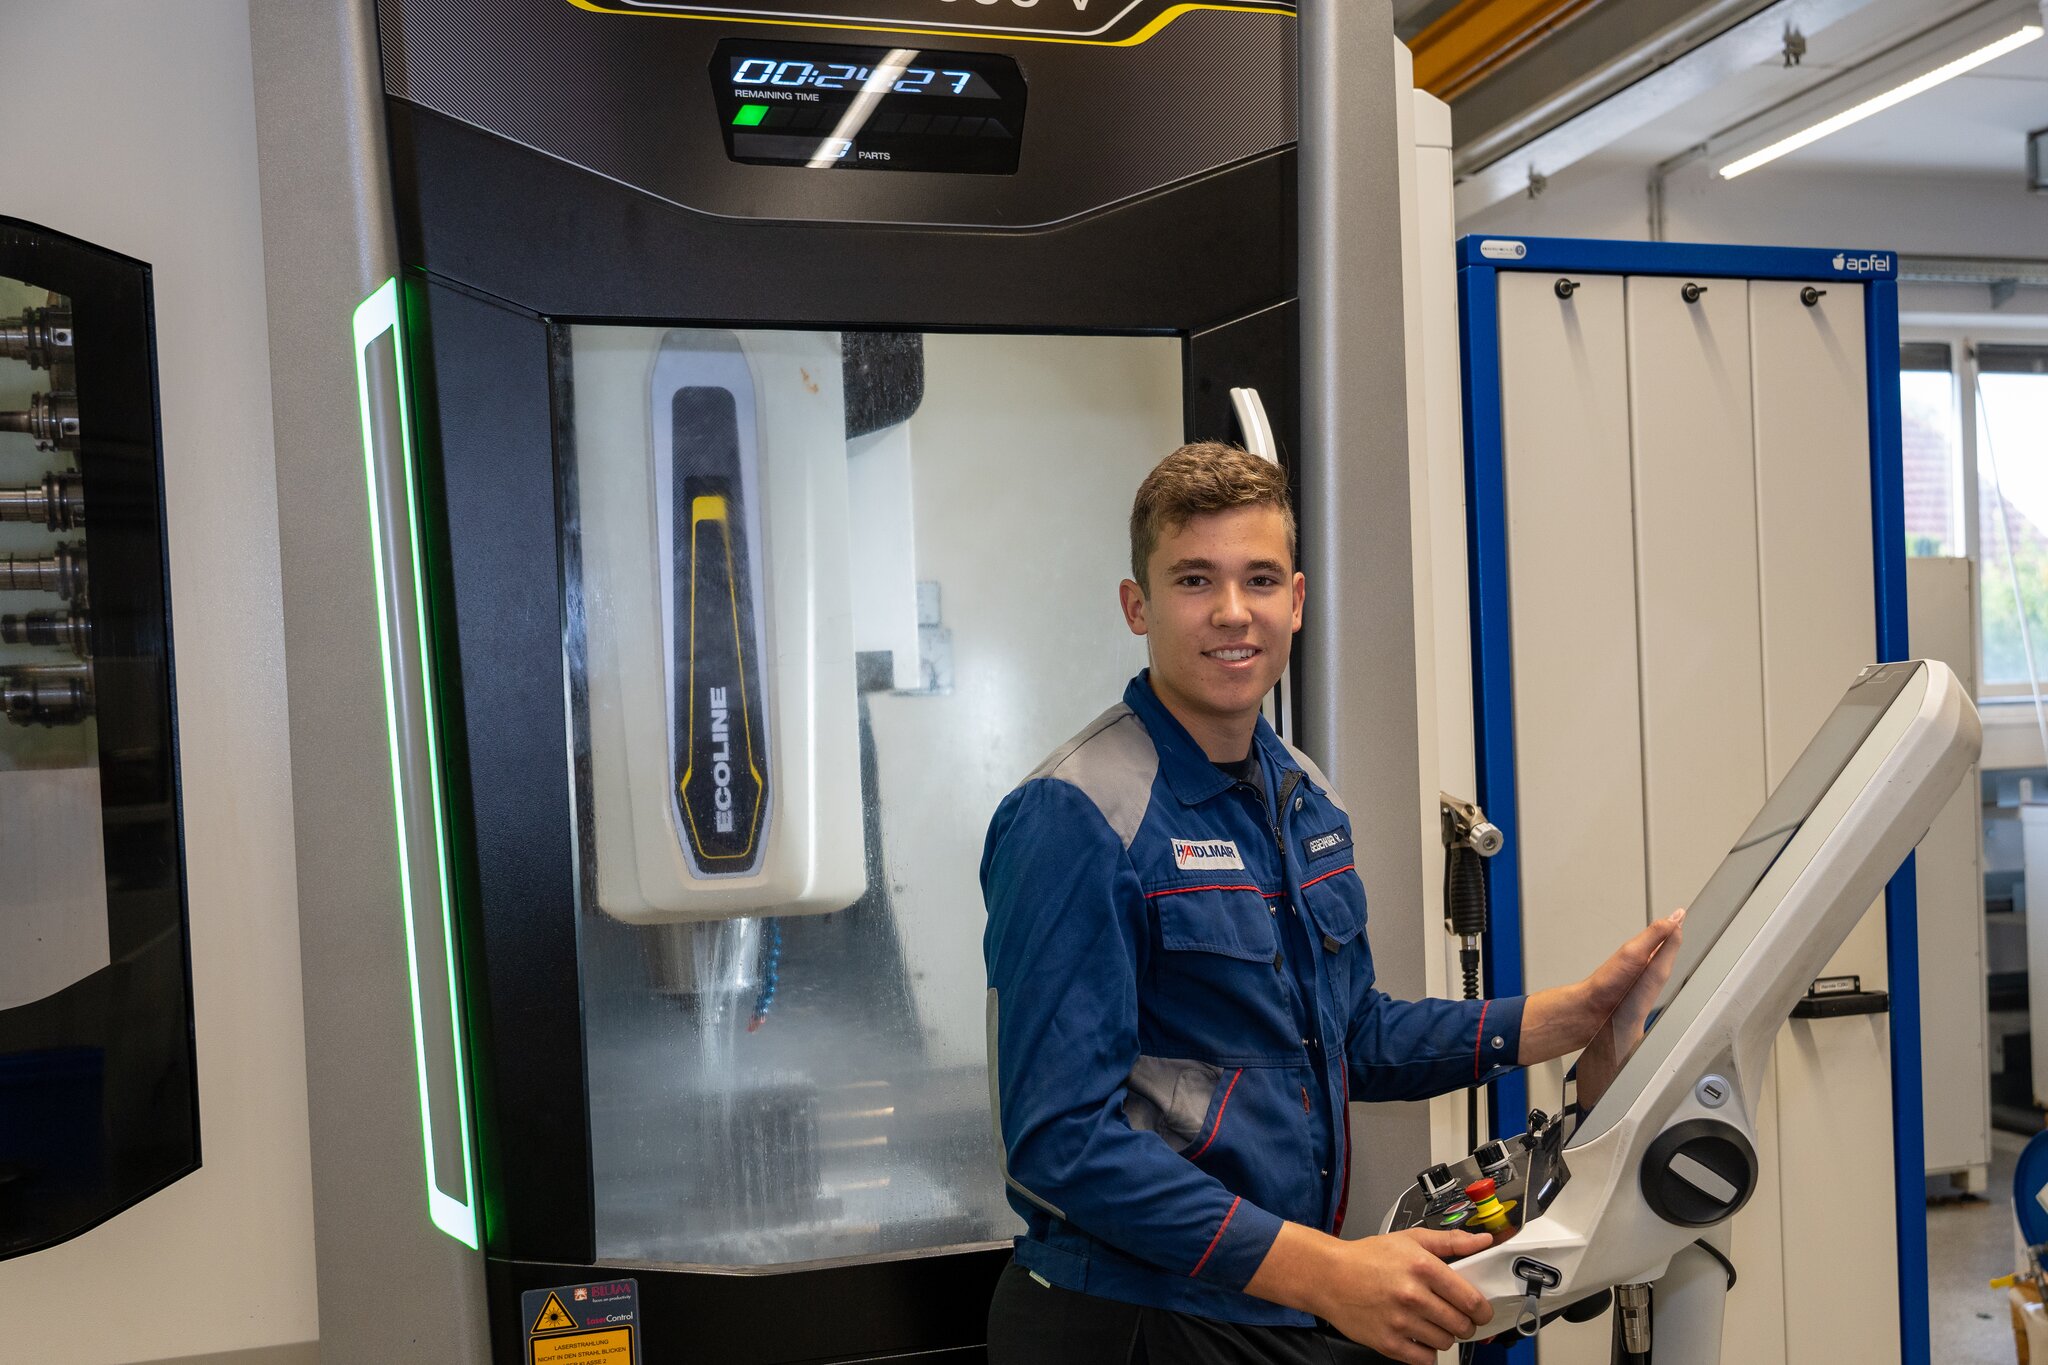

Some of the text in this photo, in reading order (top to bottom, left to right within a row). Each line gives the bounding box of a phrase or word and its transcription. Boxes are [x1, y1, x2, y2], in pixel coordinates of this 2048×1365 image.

[734, 89, 820, 102] REMAINING TIME
[858, 151, 891, 160] PARTS
[1846, 254, 1890, 274] apfel
[710, 686, 733, 832] ECOLINE
[554, 1339, 609, 1351] LASERSTRAHLUNG
[537, 1355, 556, 1363] NICHT
[601, 1346, 626, 1354] BLICKEN
